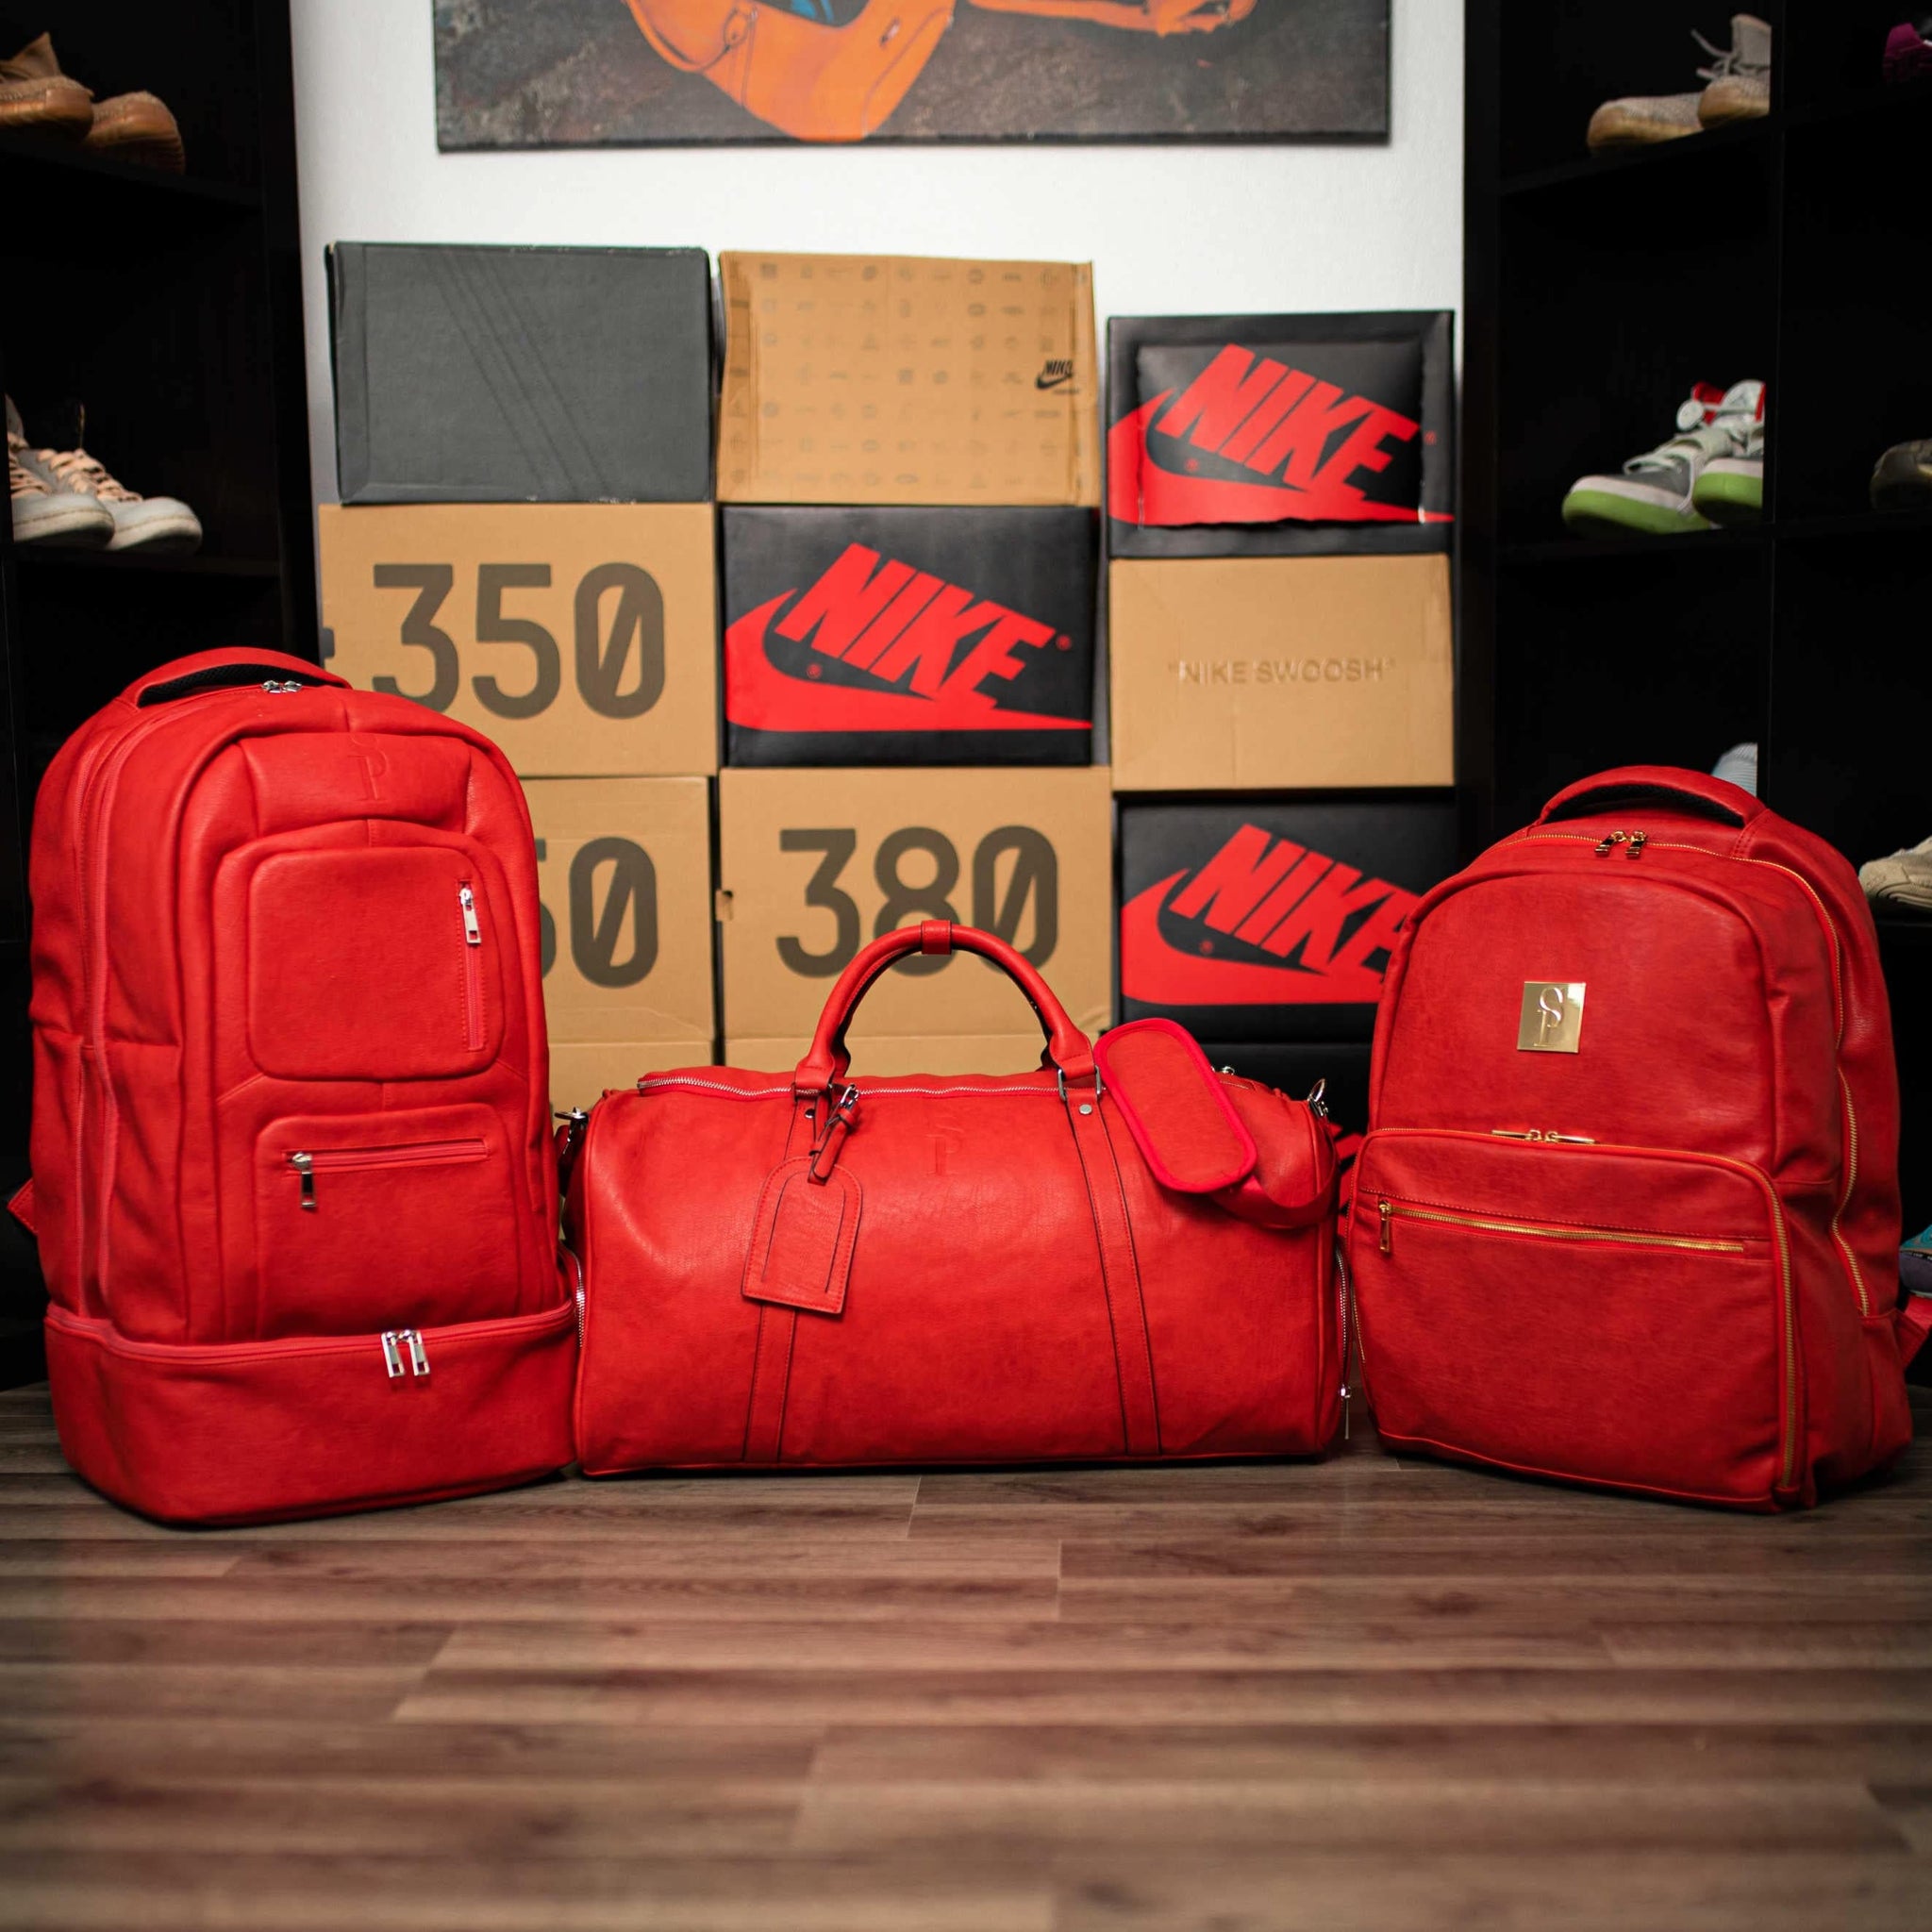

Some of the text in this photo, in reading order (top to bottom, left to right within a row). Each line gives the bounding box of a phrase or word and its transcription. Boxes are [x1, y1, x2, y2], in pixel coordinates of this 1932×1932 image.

[1155, 342, 1421, 502] NIKE
[372, 561, 666, 720] 350
[774, 541, 1057, 709] NIKE
[774, 825, 1058, 978] 380
